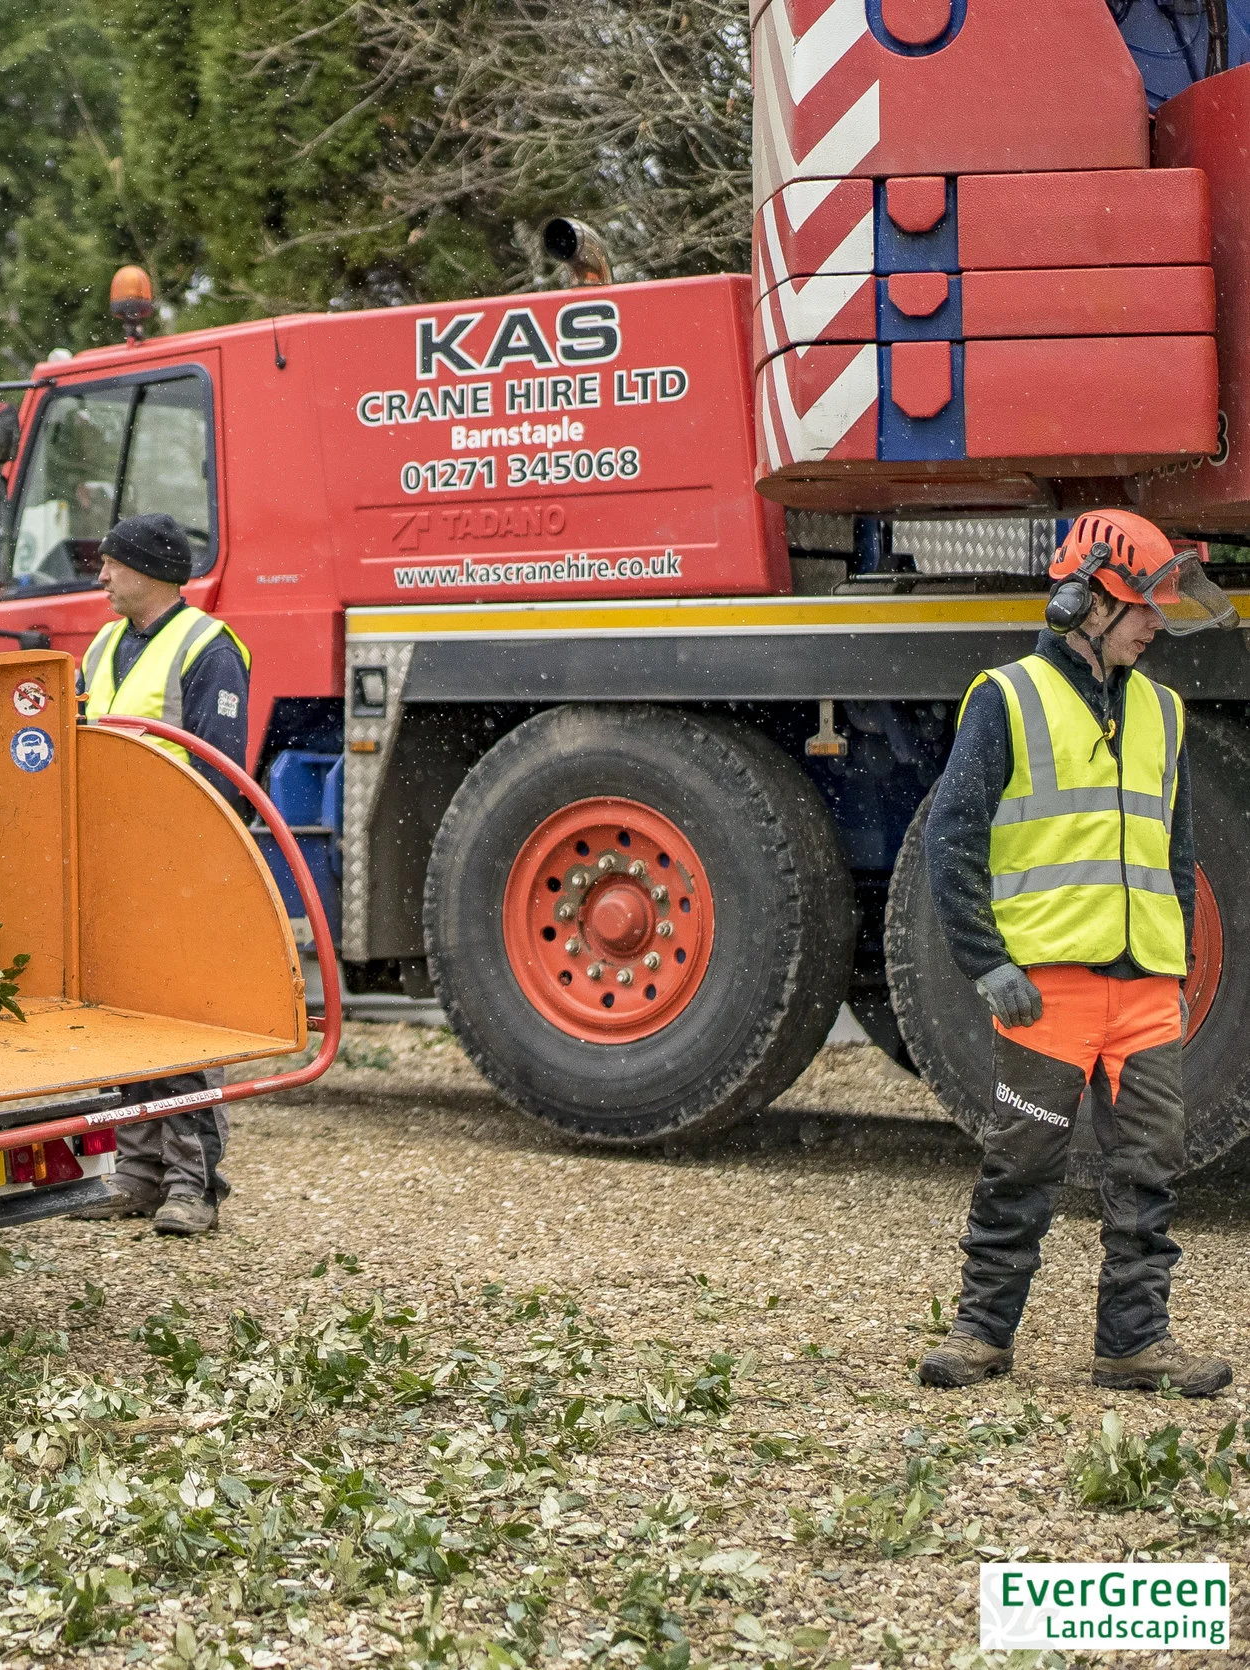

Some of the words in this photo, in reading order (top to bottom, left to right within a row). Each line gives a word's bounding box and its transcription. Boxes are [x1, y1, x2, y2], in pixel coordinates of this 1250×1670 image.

[416, 301, 622, 380] KAS
[357, 381, 493, 427] CRANE
[506, 372, 600, 414] HIRE
[614, 366, 688, 405] LTD
[451, 417, 584, 451] Barnstaple
[402, 456, 495, 494] 01271
[508, 446, 639, 487] 345068
[442, 504, 565, 540] TADANO
[394, 549, 681, 588] www.kascranehire.co.uk
[114, 1110, 125, 1118] TO
[154, 1100, 173, 1110] PULL
[174, 1098, 184, 1107] TO
[186, 1090, 219, 1104] REVERSE
